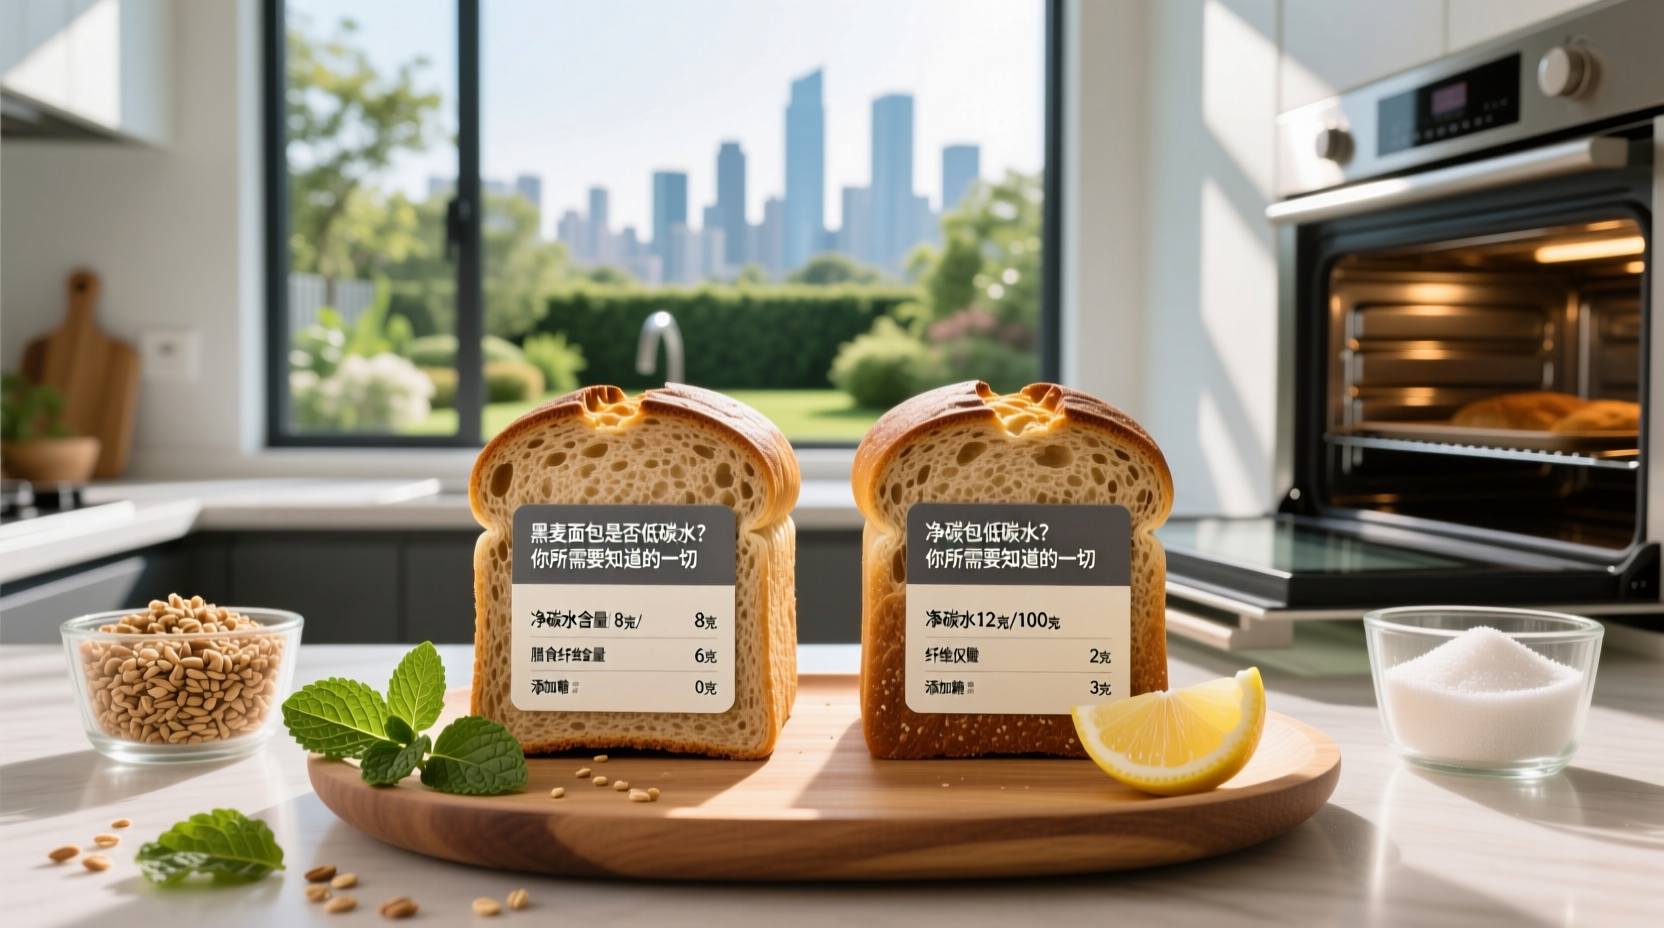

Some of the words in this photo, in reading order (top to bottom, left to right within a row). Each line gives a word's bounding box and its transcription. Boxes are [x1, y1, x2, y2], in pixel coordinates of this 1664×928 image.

[530, 548, 698, 569] 你所需要知道的一切
[925, 547, 1096, 569] 你所需要知道的一切
[694, 647, 718, 664] 6克
[1089, 648, 1112, 665] 2克
[1089, 680, 1112, 697] 3克
